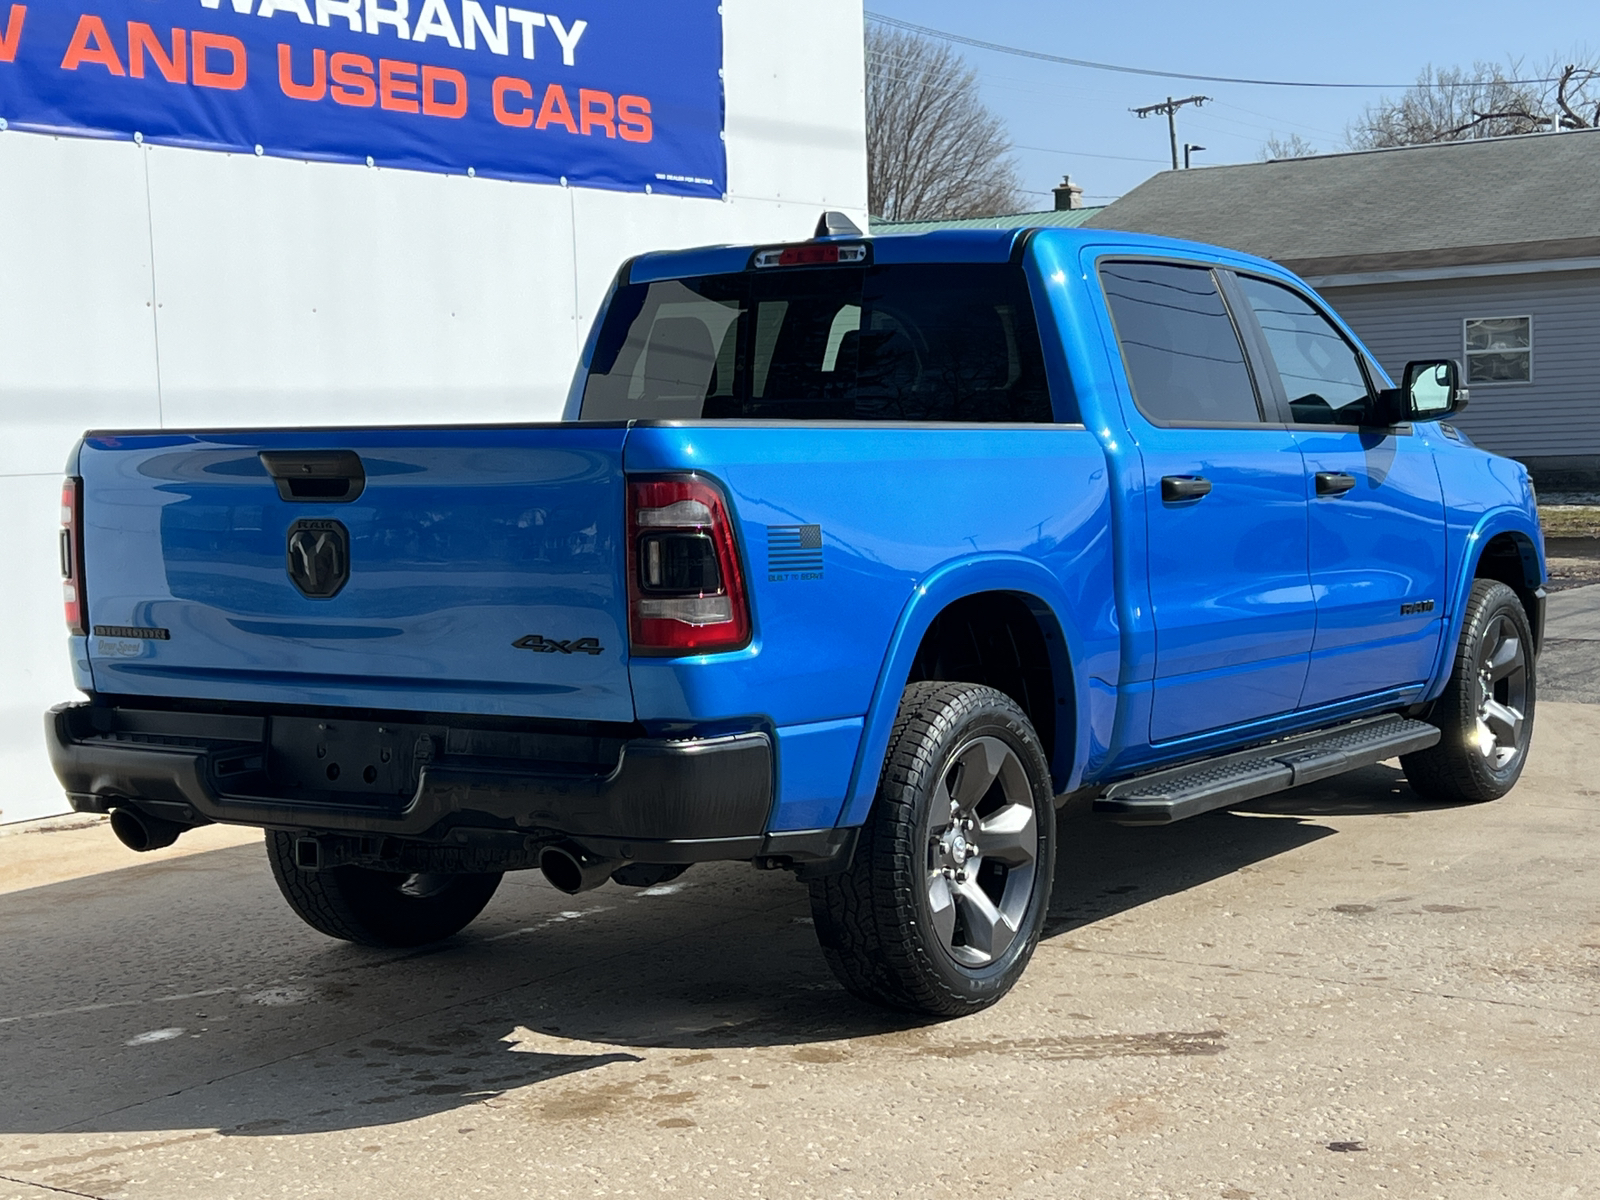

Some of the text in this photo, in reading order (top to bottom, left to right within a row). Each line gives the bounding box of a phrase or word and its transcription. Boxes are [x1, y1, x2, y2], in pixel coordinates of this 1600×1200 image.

[201, 0, 588, 66] RRANTY
[60, 14, 247, 90] AND
[277, 43, 468, 119] USED
[492, 76, 653, 143] CARS
[768, 574, 789, 582] BUILT
[801, 572, 824, 580] SERVE
[1400, 599, 1435, 616] RAM
